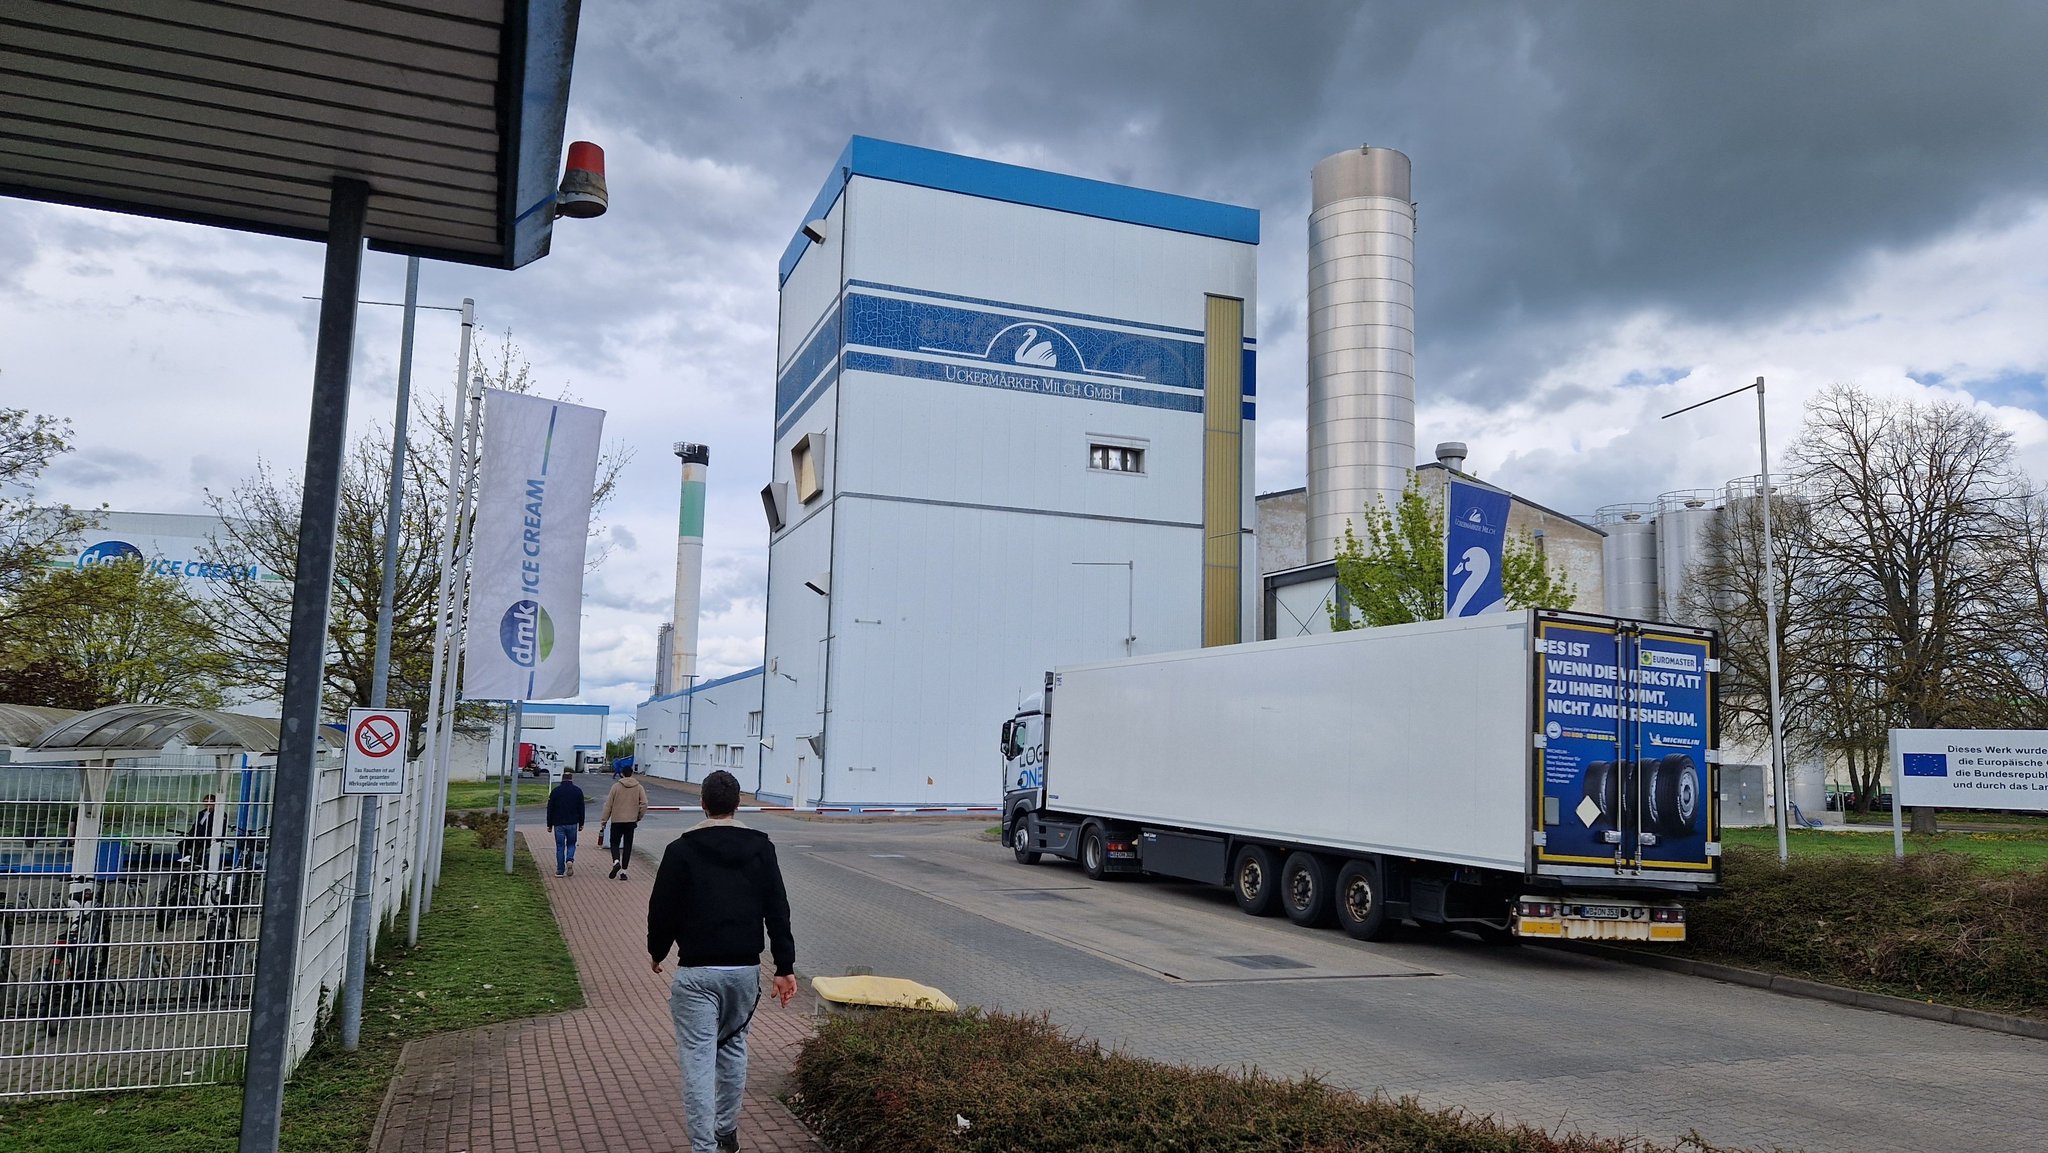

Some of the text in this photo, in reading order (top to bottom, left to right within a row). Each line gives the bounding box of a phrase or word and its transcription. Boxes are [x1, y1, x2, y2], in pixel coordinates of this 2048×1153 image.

[945, 365, 1039, 391] UCKERMÄRKER
[1042, 378, 1081, 396] MILCH
[149, 558, 183, 576] ICE
[512, 479, 545, 665] dmk ICE CREAM
[1568, 642, 1590, 658] IST
[1548, 660, 1701, 689] WENN DIE WERKSTATT
[1547, 679, 1668, 707] ZU IHNEN KOMMT,
[1547, 699, 1590, 716] NICHT
[1662, 736, 1700, 745] MICHELIN
[1947, 744, 2048, 755] Dieses Werk wurde
[1958, 758, 1974, 766] die
[1977, 758, 2043, 768] Europäische
[1955, 769, 1971, 777] die
[1953, 781, 1973, 789] und
[1976, 781, 2006, 790] durch
[2009, 782, 2028, 790] das
